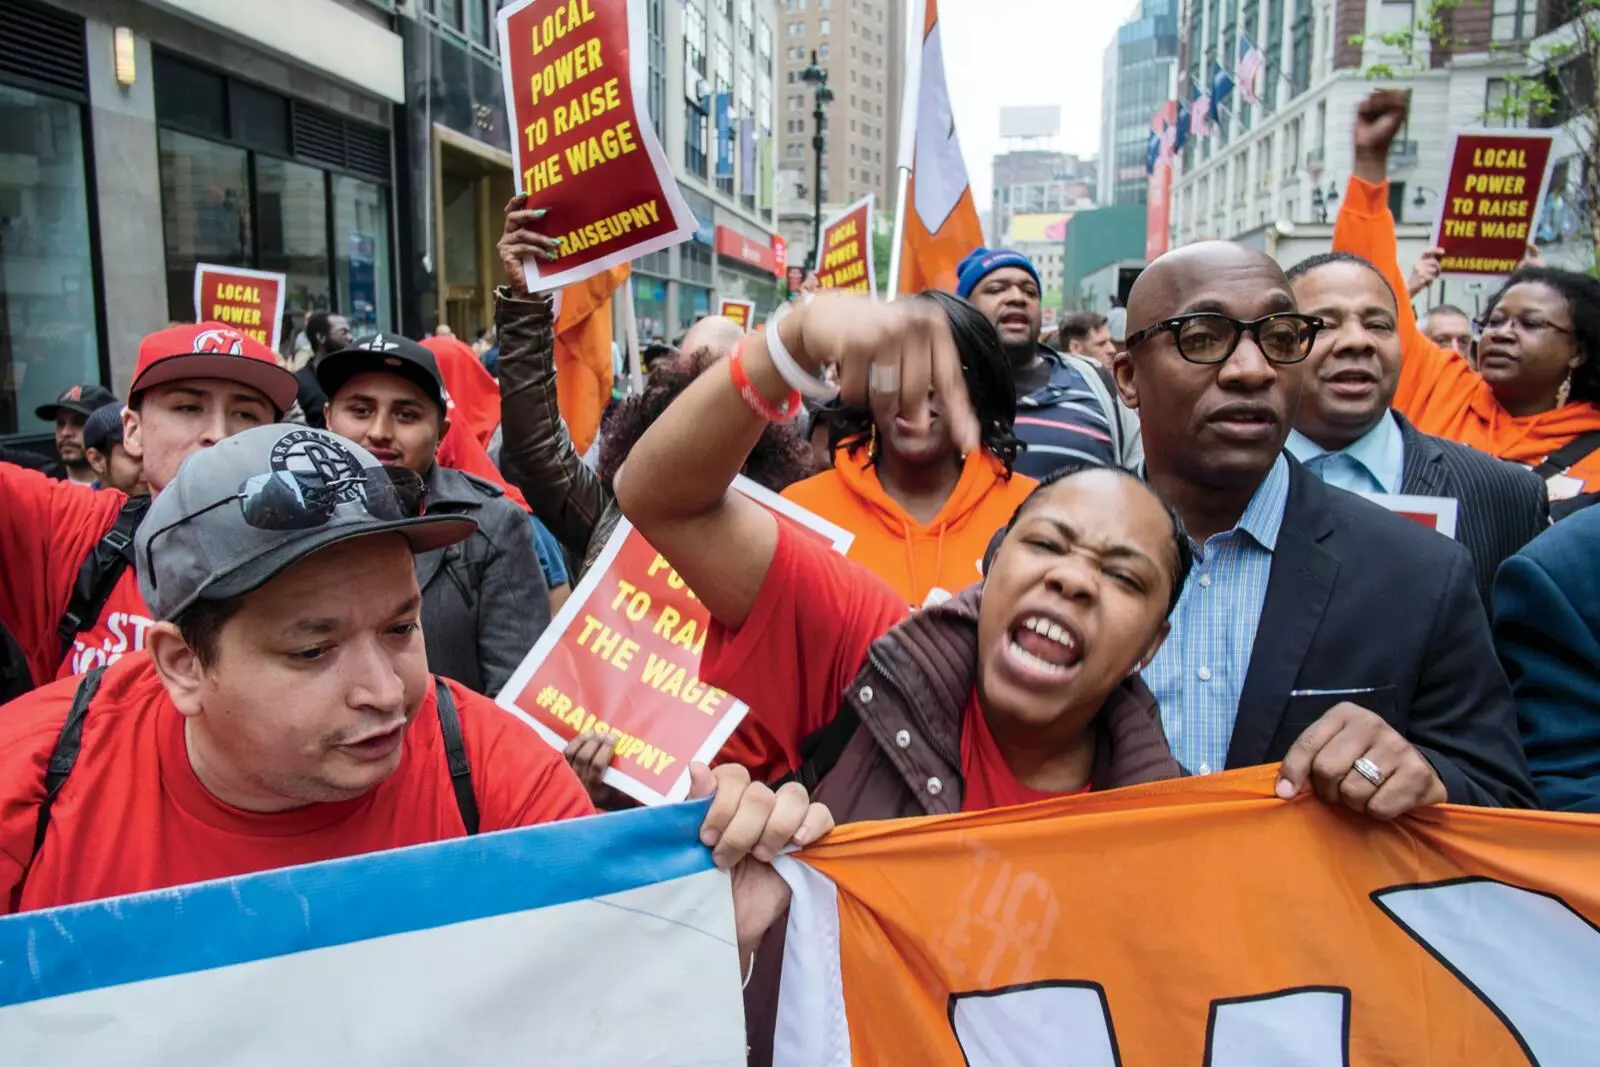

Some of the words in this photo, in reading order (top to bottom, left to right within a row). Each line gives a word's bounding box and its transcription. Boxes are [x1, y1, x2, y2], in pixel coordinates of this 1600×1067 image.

[532, 0, 596, 55] LOCAL
[531, 37, 604, 106] POWER
[525, 117, 549, 152] TO
[553, 77, 621, 136] RAISE
[524, 153, 564, 197] THE
[565, 120, 637, 175] WAGE
[1472, 148, 1528, 168] LOCAL
[1464, 174, 1526, 194] POWER
[558, 199, 660, 257] RAISEUPNY
[1452, 197, 1474, 215] TO
[1477, 199, 1529, 217] RAISE
[1444, 220, 1477, 238] THE
[1481, 221, 1528, 240] WAGE
[213, 304, 262, 325] POWER
[216, 283, 261, 304] LOCAL
[611, 580, 651, 622] TO
[576, 614, 641, 672] THE
[640, 652, 728, 717] WAGE
